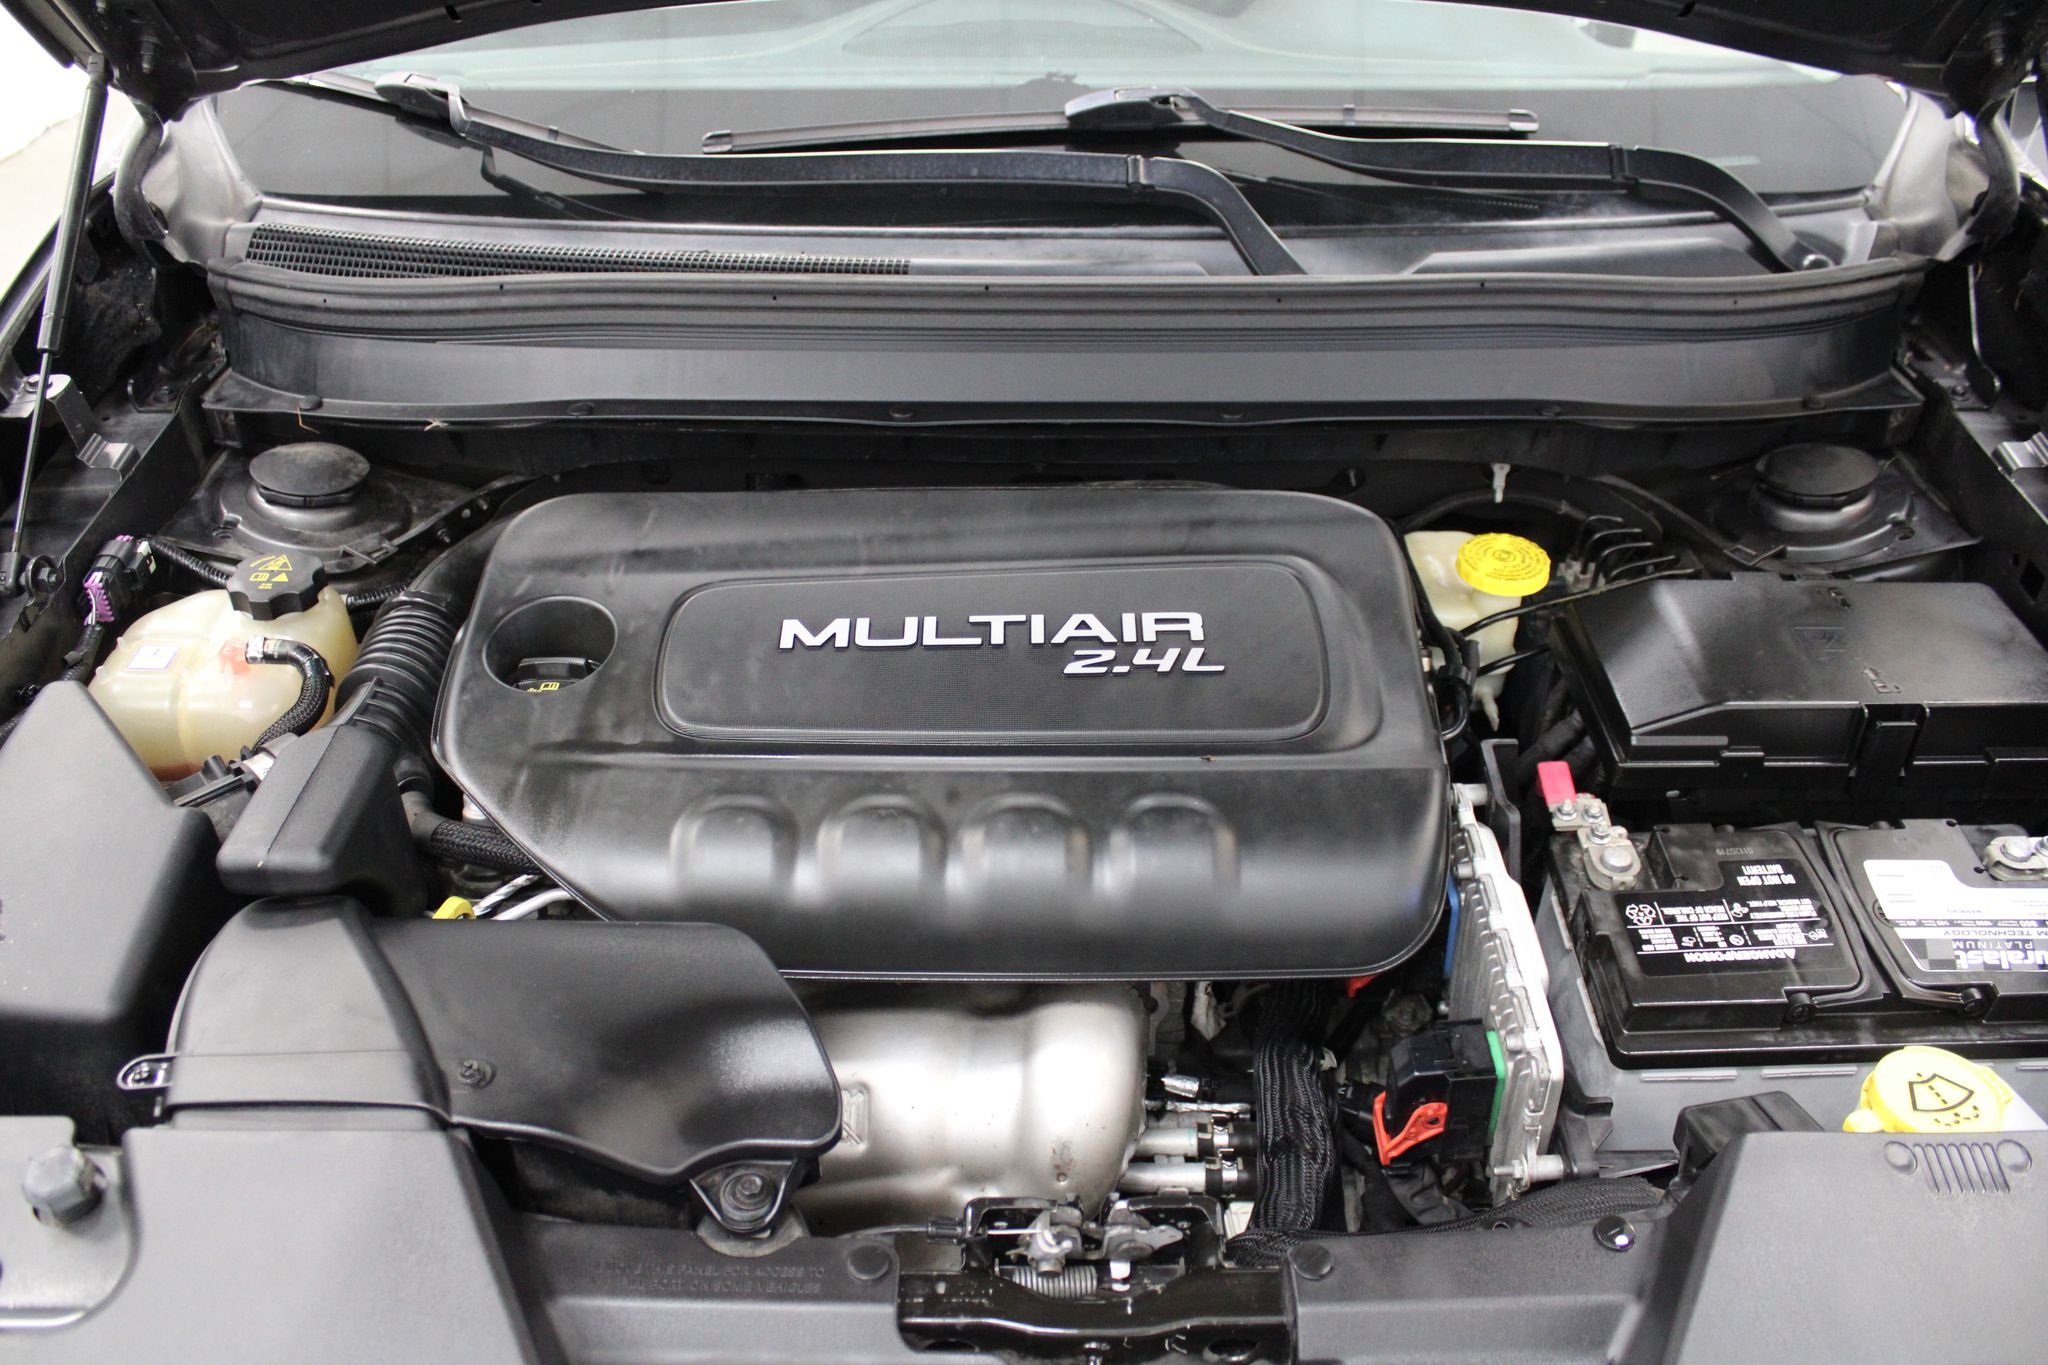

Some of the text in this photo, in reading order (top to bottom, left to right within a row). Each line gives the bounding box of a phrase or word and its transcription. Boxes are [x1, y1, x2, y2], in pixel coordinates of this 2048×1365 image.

[778, 610, 1205, 651] MULTIAIR
[1061, 646, 1226, 677] 2.4L
[1736, 874, 1797, 886] DO NOT OPEN
[1951, 940, 2033, 949] PLATINUM
